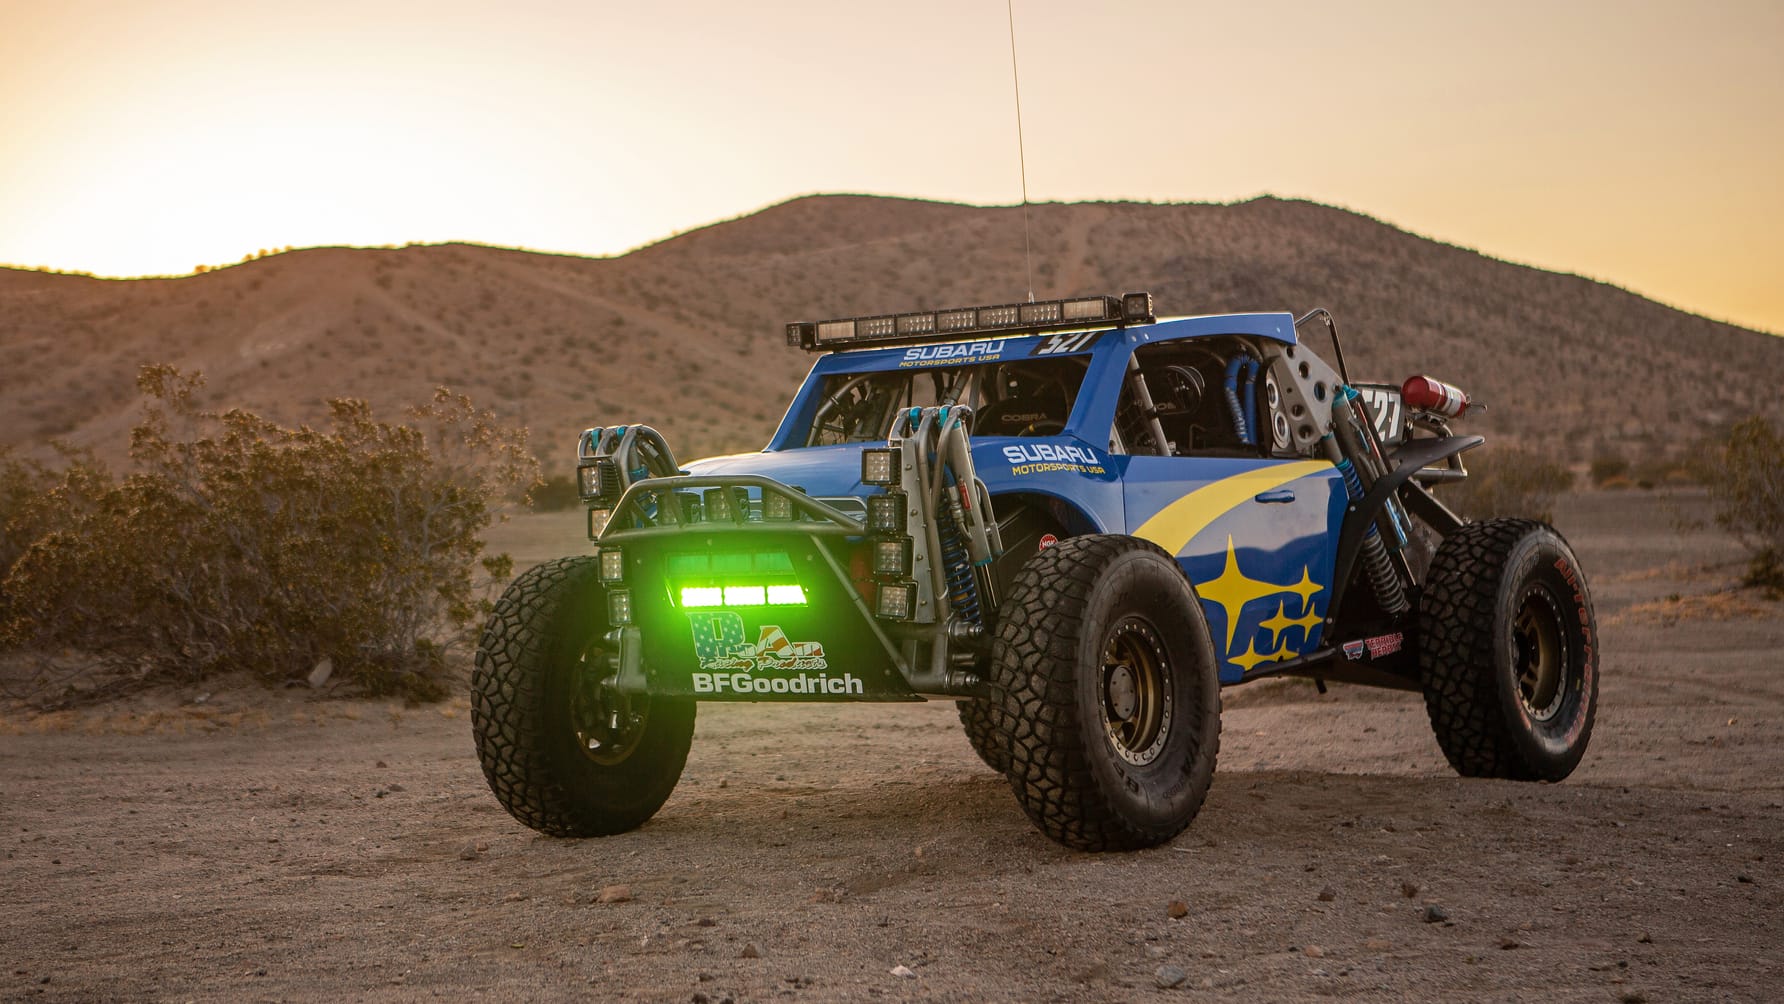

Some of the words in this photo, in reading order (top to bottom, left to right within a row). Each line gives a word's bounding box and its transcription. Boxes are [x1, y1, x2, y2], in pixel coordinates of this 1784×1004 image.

[903, 340, 1006, 361] SUBARU
[899, 356, 976, 368] MOTORSPORTS
[978, 353, 1001, 362] USA
[1001, 412, 1048, 422] COBRA
[1002, 444, 1099, 464] SUBARU
[1011, 462, 1087, 476] MOTORSPORTS
[1087, 465, 1106, 475] USA
[699, 656, 756, 673] Racing
[691, 672, 865, 695] BFGoodrich
